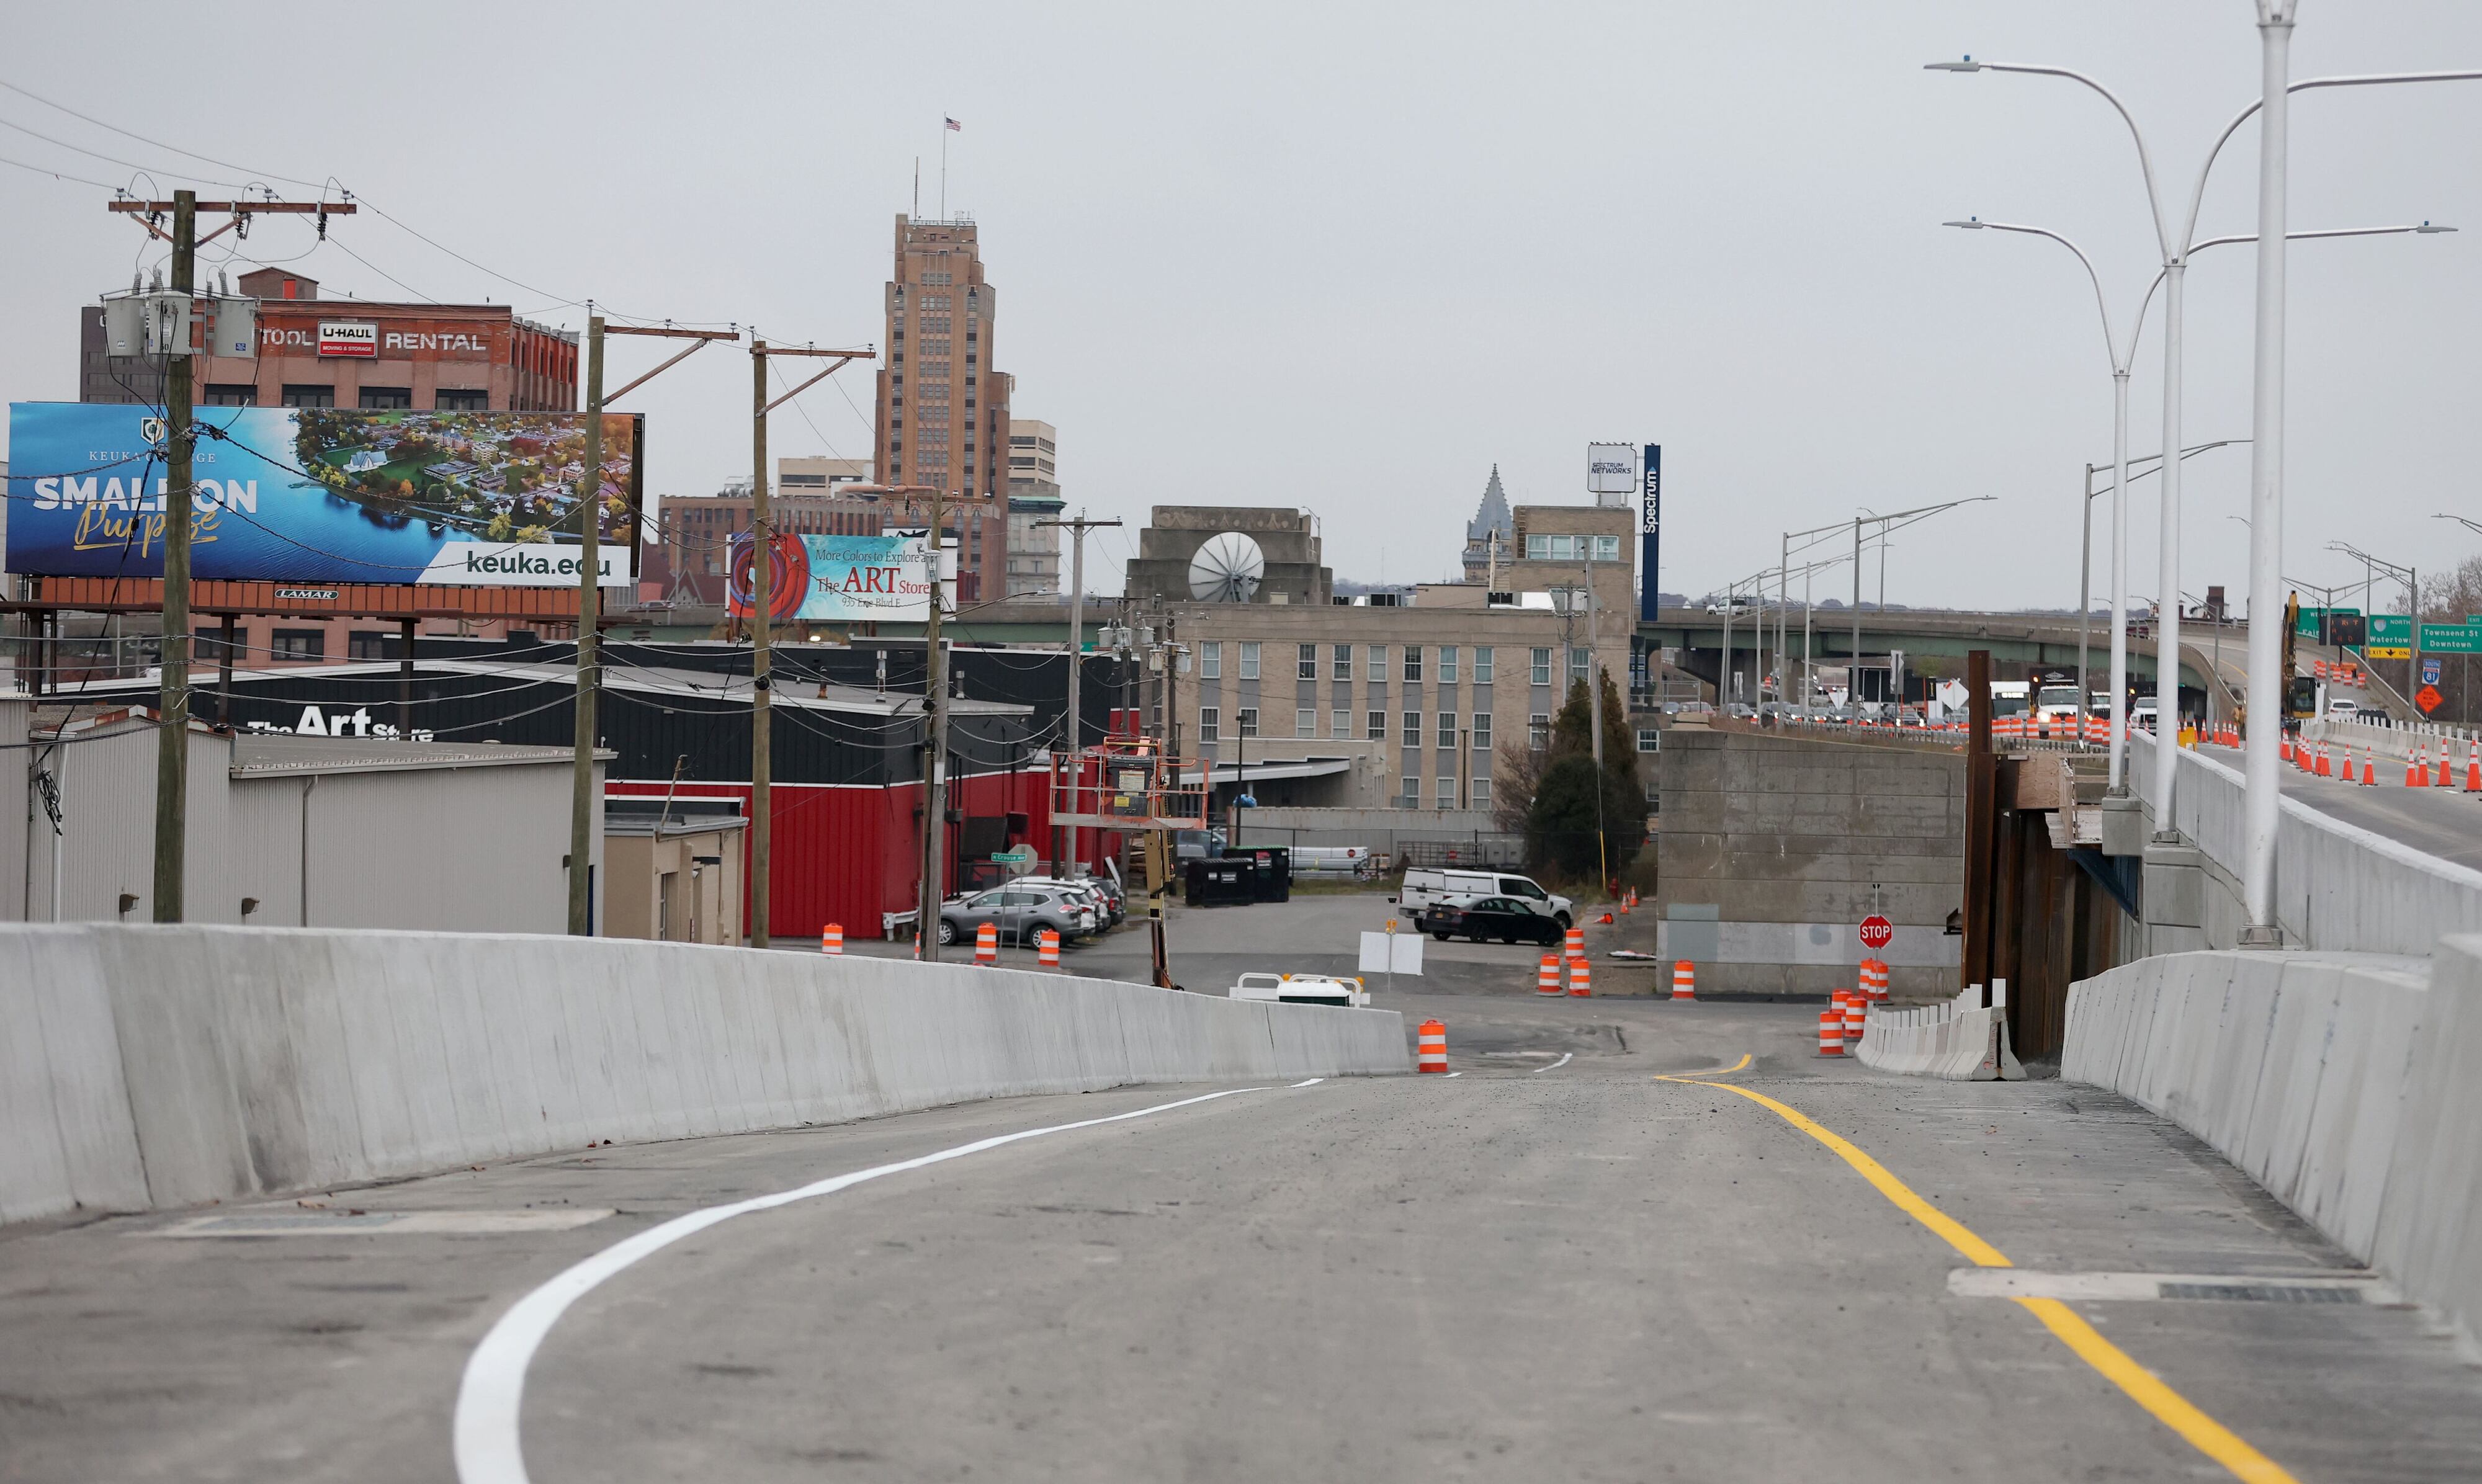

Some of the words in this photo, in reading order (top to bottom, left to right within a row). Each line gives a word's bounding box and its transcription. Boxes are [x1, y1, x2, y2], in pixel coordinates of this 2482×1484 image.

[259, 328, 315, 346] TOOL
[323, 328, 372, 338] U-HAUL
[385, 333, 487, 351] RENTAL
[89, 451, 141, 462] KEUKA
[1644, 471, 1659, 534] Spectrum
[74, 501, 223, 558] Purpse
[815, 550, 841, 561] More
[843, 550, 872, 561] Colors
[874, 552, 883, 561] to
[885, 550, 920, 565] Explore
[817, 577, 840, 592] The
[841, 566, 901, 594] ART
[899, 580, 930, 594] Store
[841, 597, 855, 607] 935
[876, 597, 893, 607] Blvd
[2426, 672, 2435, 681] 81
[295, 705, 372, 740] Art
[1862, 926, 1890, 939] STOP
